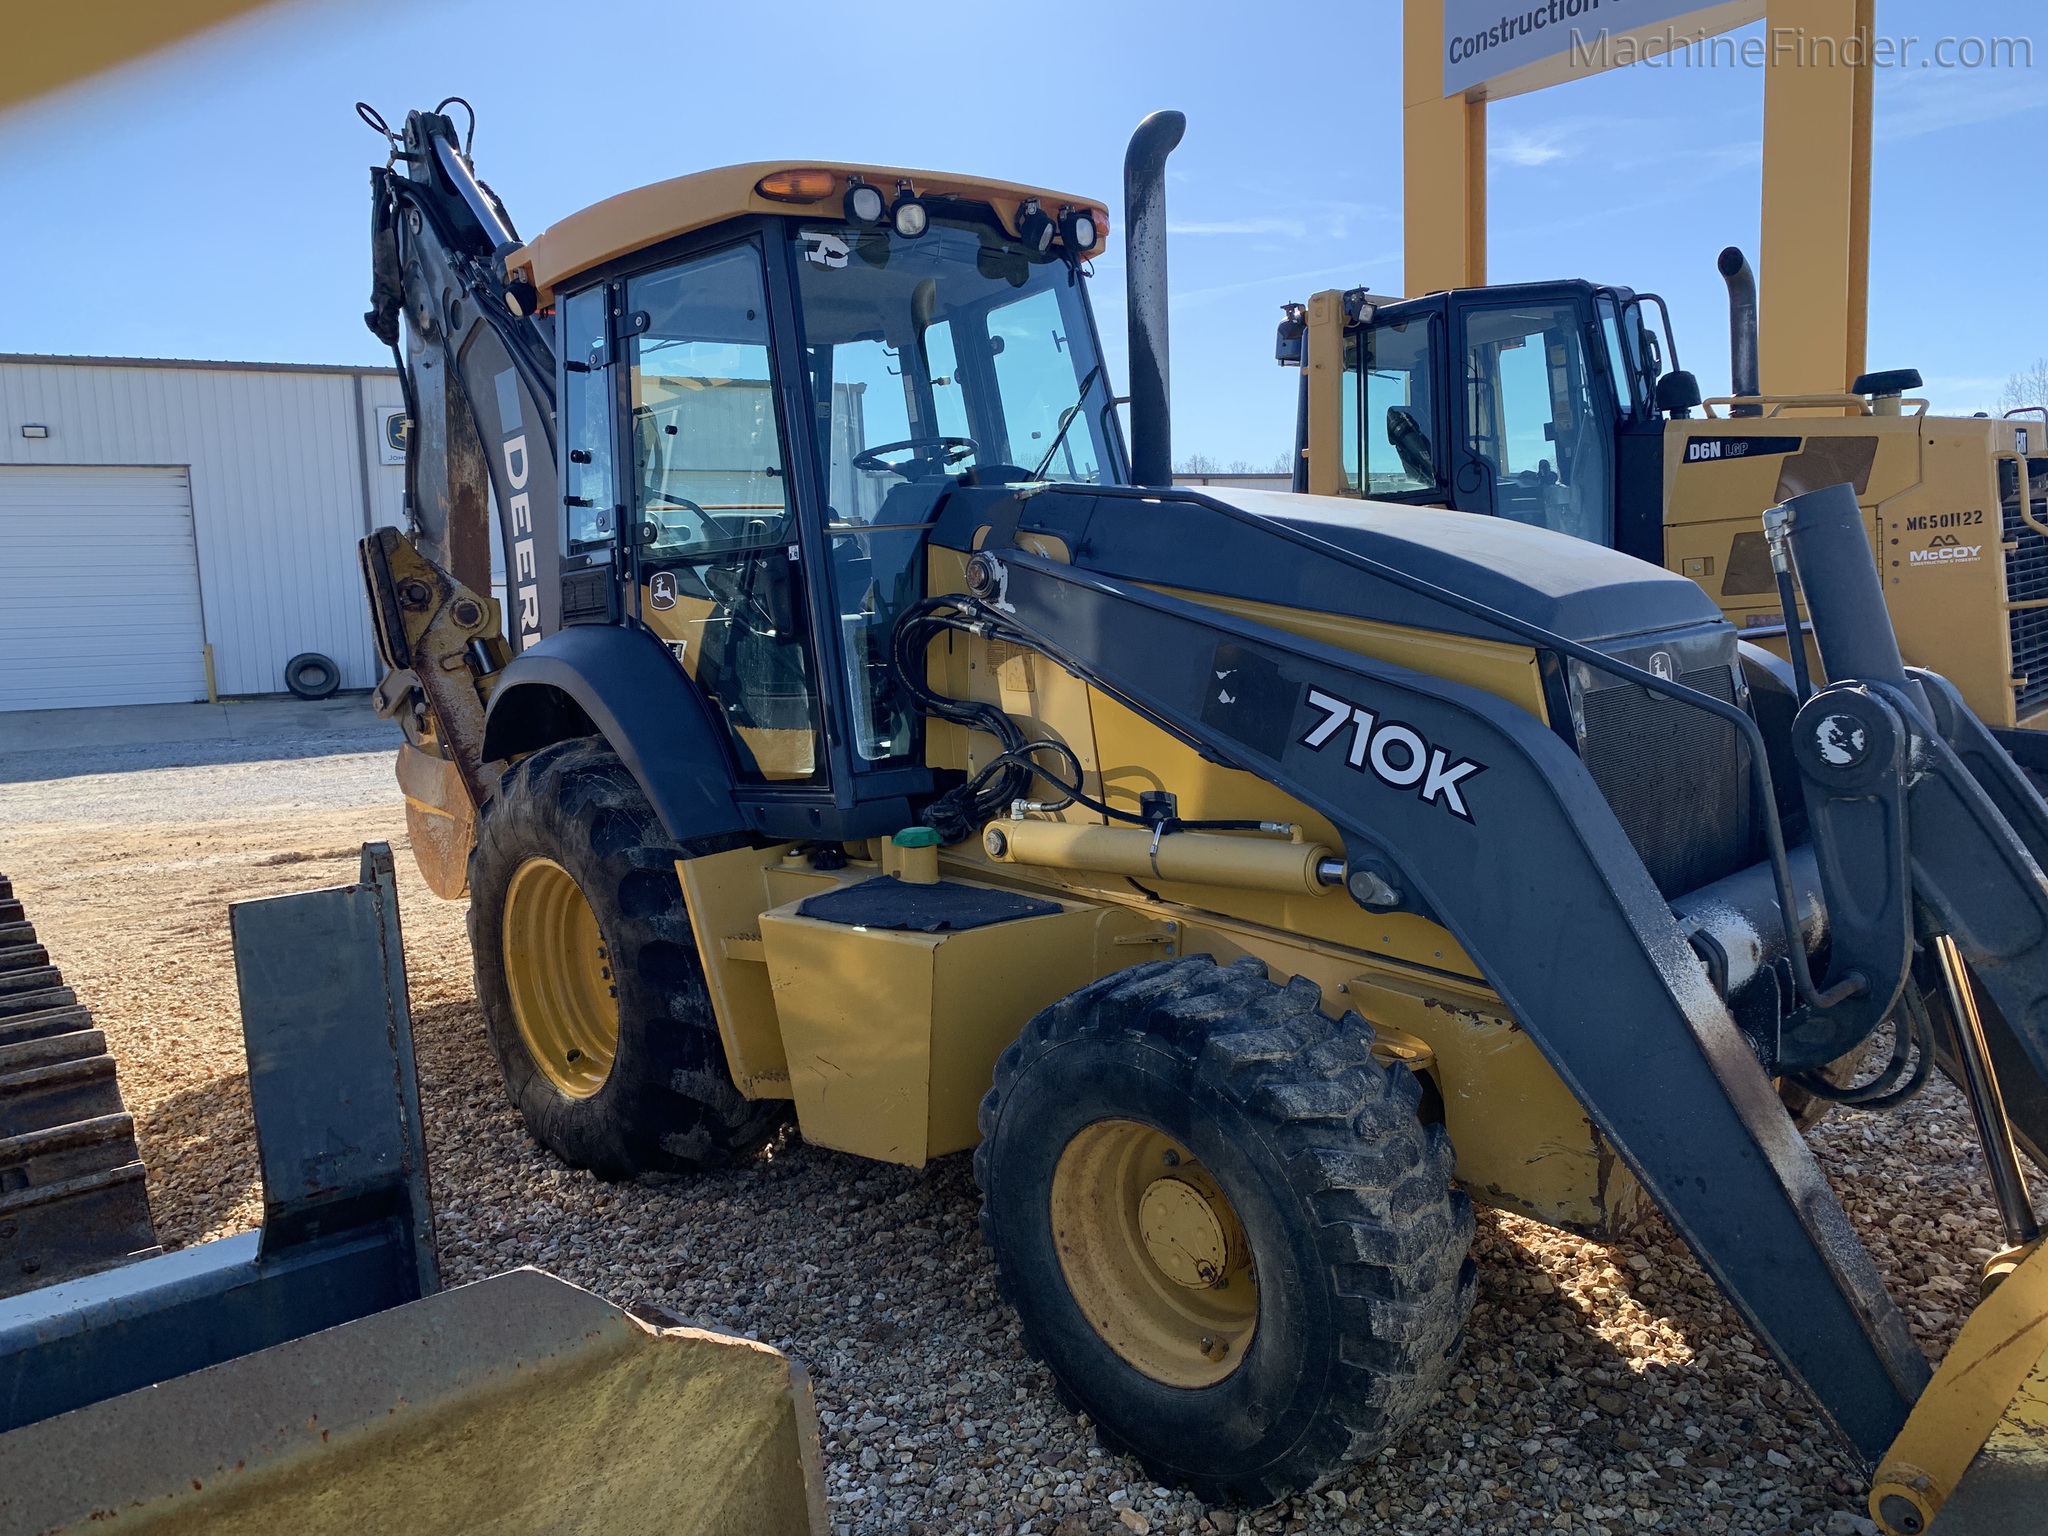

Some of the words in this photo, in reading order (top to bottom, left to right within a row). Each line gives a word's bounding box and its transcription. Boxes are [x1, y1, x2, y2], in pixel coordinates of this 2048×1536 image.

[388, 454, 406, 462] JOH
[1690, 441, 1721, 460] D6N
[1725, 442, 1748, 456] LGP
[1909, 545, 1981, 561] McCOY
[1298, 684, 1488, 825] 710K
